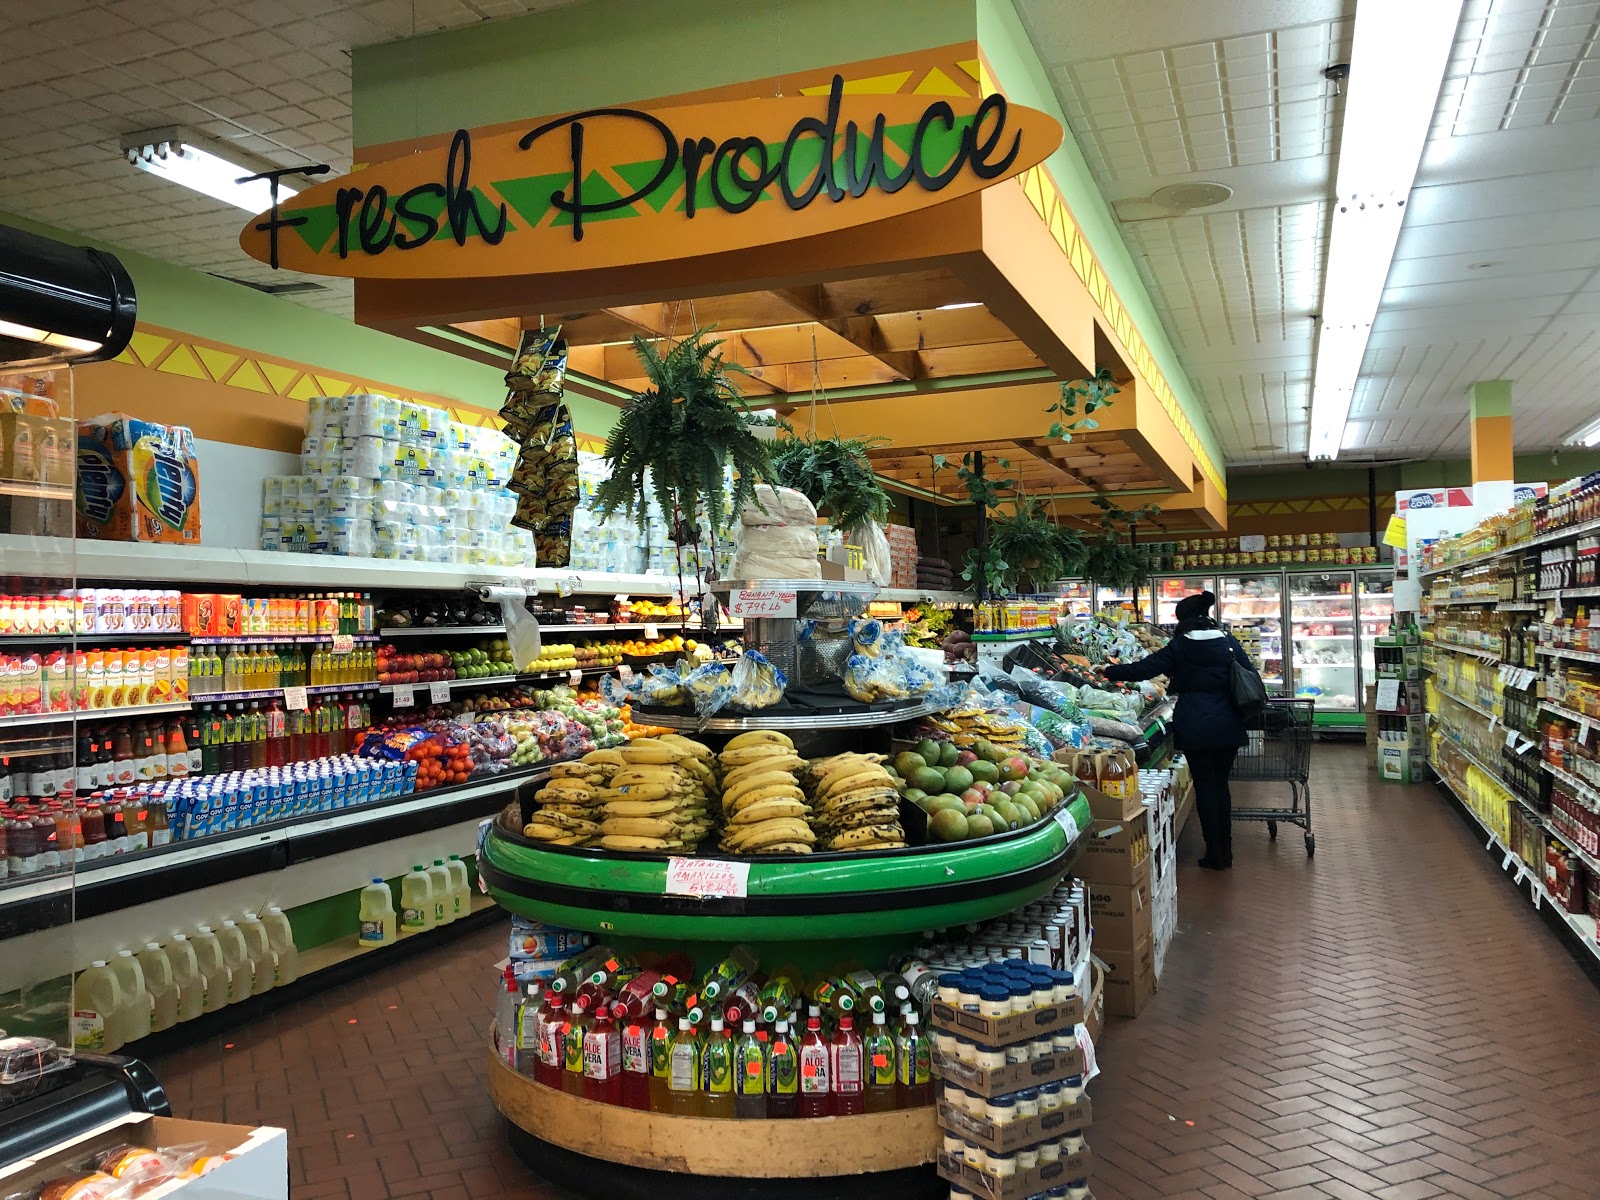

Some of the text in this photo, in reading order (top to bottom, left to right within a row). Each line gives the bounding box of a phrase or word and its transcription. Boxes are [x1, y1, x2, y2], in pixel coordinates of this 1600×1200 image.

[235, 74, 1022, 269] Fresh Produce
[406, 420, 420, 428] BATH
[404, 460, 418, 468] BATH
[1410, 499, 1433, 508] GOYA
[1411, 494, 1430, 503] MALTA
[395, 696, 410, 704] $1.49
[210, 808, 222, 816] GOY
[673, 860, 731, 870] PLATANOS
[672, 871, 735, 881] AMARILLOS
[1101, 910, 1125, 918] VINEGAR
[624, 1036, 641, 1048] ALOE
[584, 1042, 601, 1054] ALOE
[624, 1047, 642, 1058] VERA
[584, 1054, 602, 1064] VERA
[805, 1056, 825, 1067] ALOE
